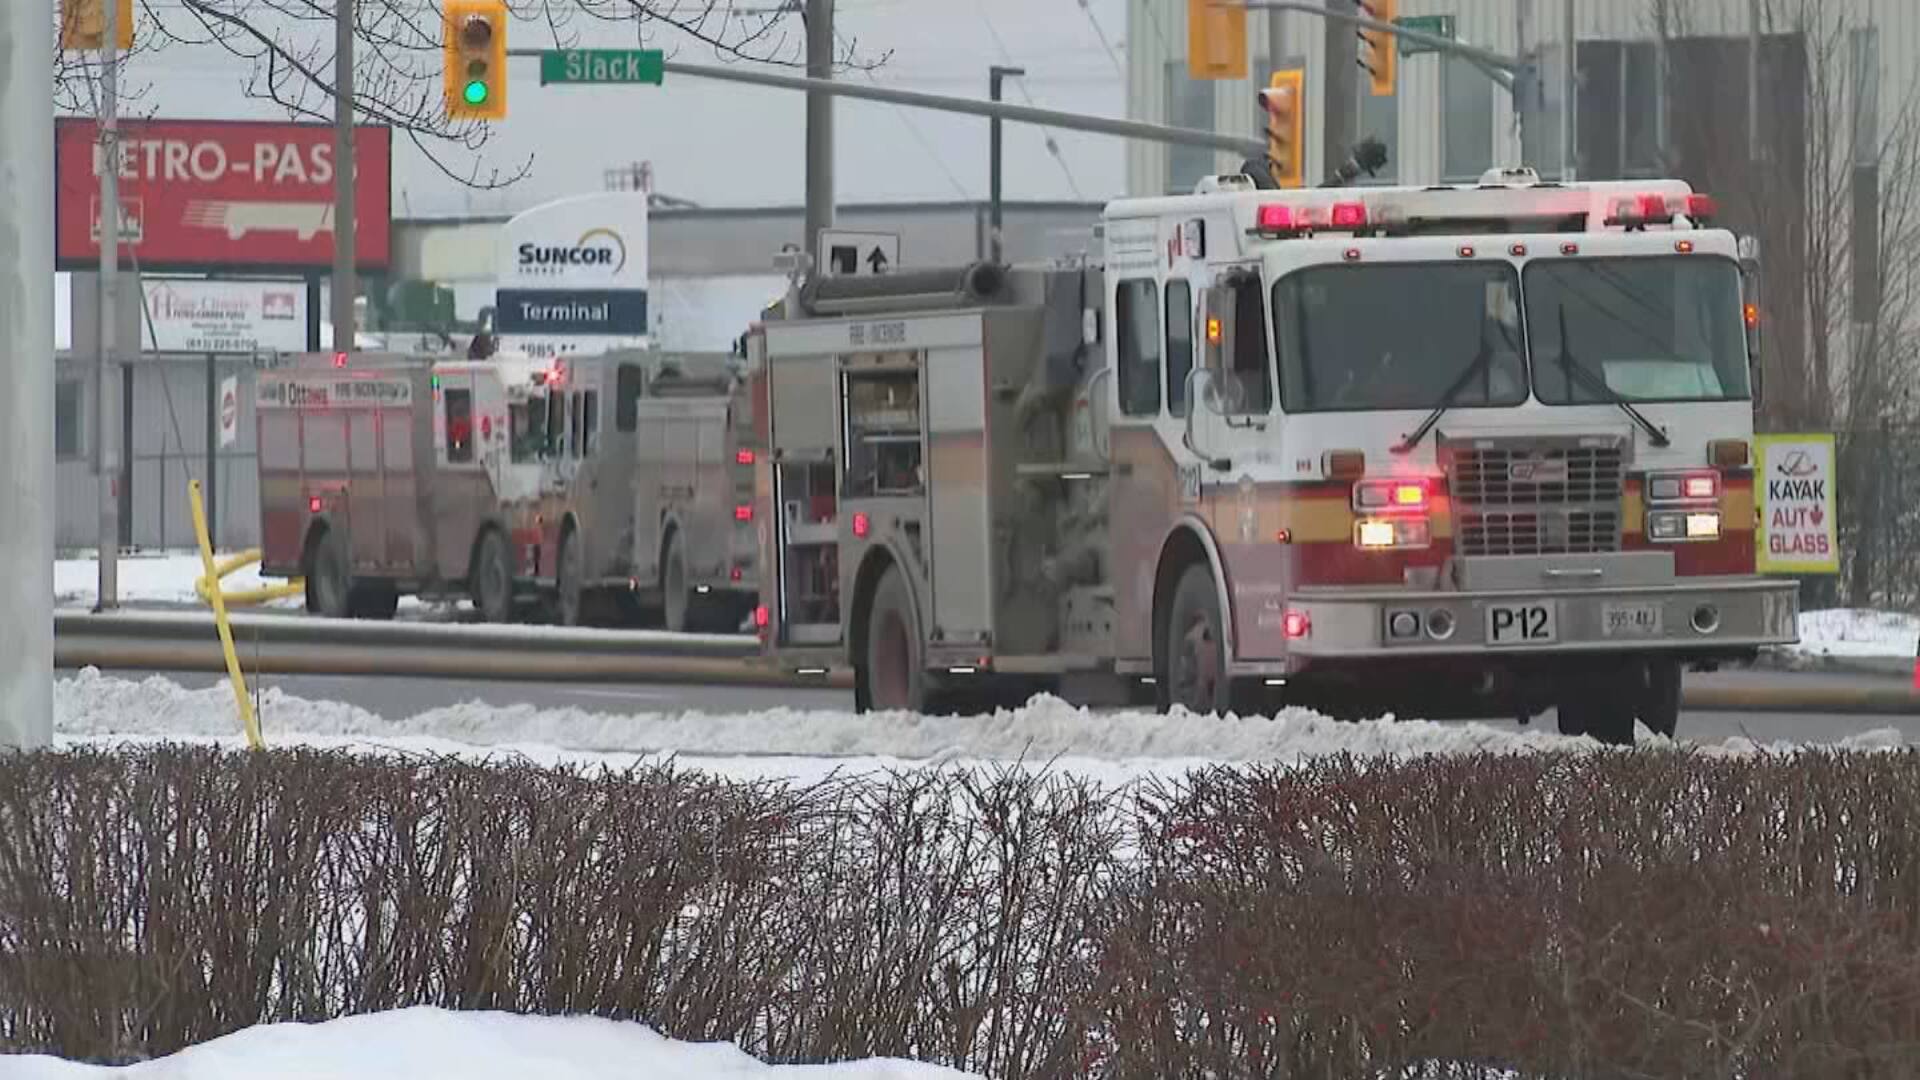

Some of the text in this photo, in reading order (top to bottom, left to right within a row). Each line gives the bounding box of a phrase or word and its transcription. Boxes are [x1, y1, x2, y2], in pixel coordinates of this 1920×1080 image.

[566, 52, 640, 80] Slack
[91, 139, 356, 182] ETRO-PAS
[520, 302, 609, 321] Terminal
[1770, 480, 1825, 500] KAYAK
[1770, 534, 1829, 554] GLASS
[1492, 606, 1549, 640] P12
